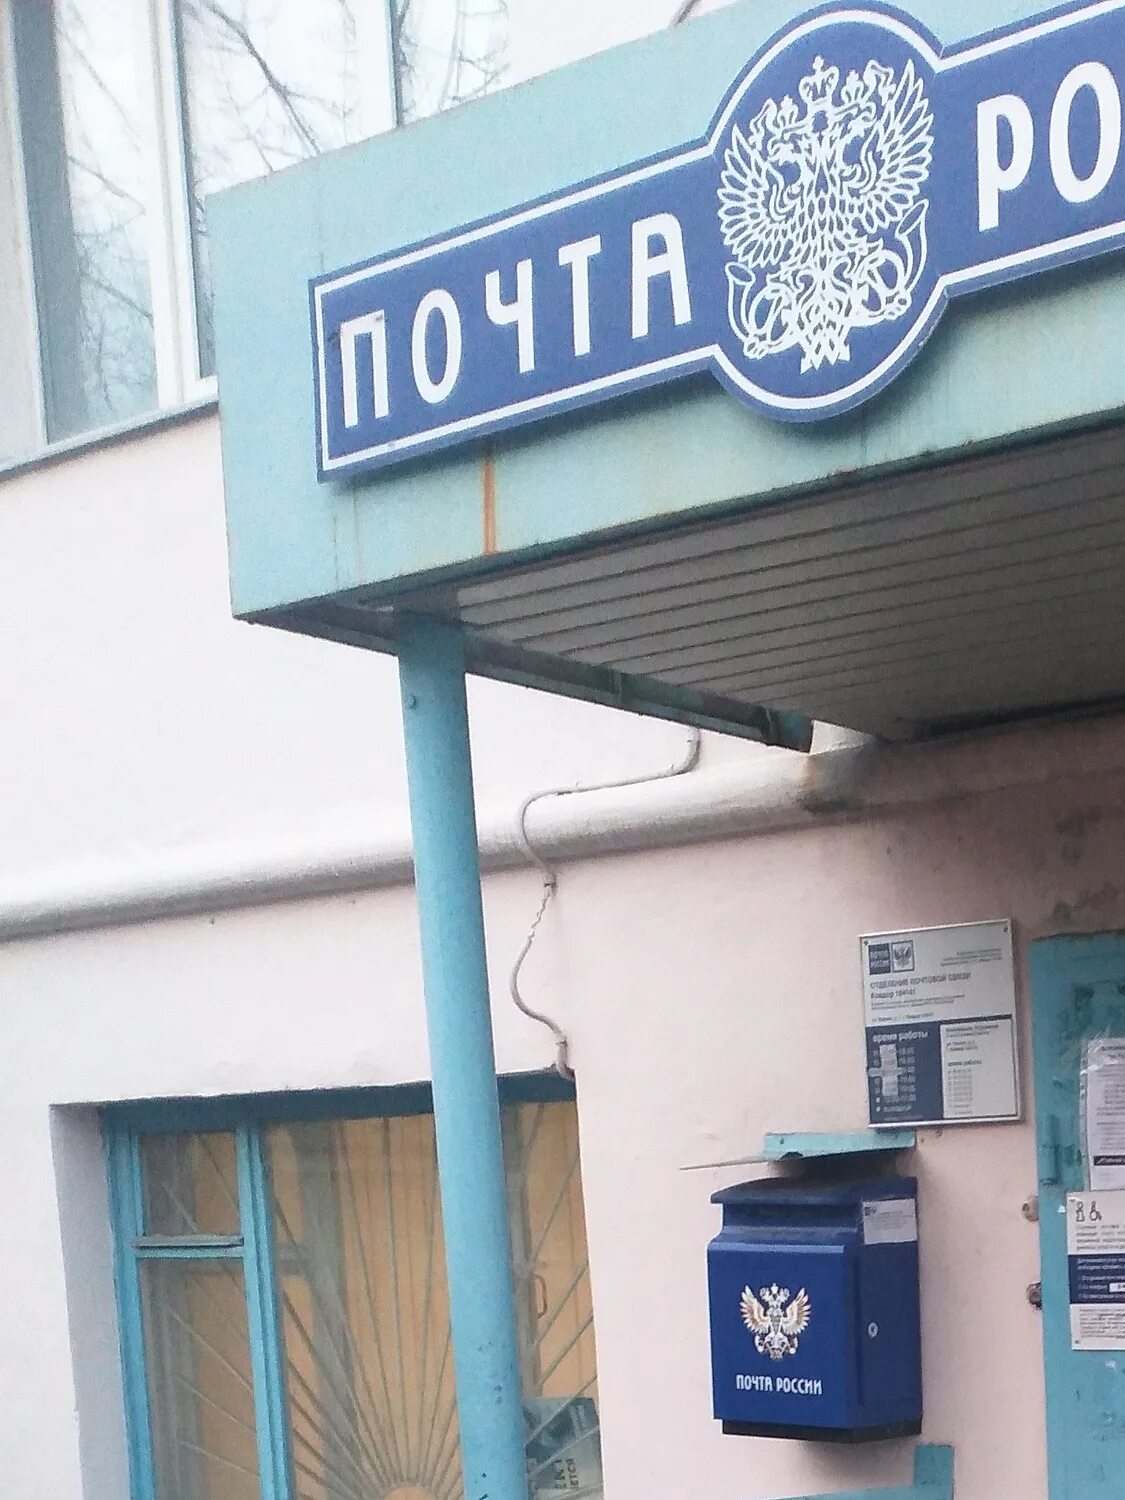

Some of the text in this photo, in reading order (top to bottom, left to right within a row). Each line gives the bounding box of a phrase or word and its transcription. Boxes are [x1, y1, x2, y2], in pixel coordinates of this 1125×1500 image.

[339, 211, 693, 430] ПОЧТА
[736, 1374, 823, 1396] ПОЧТА РОССИИ
